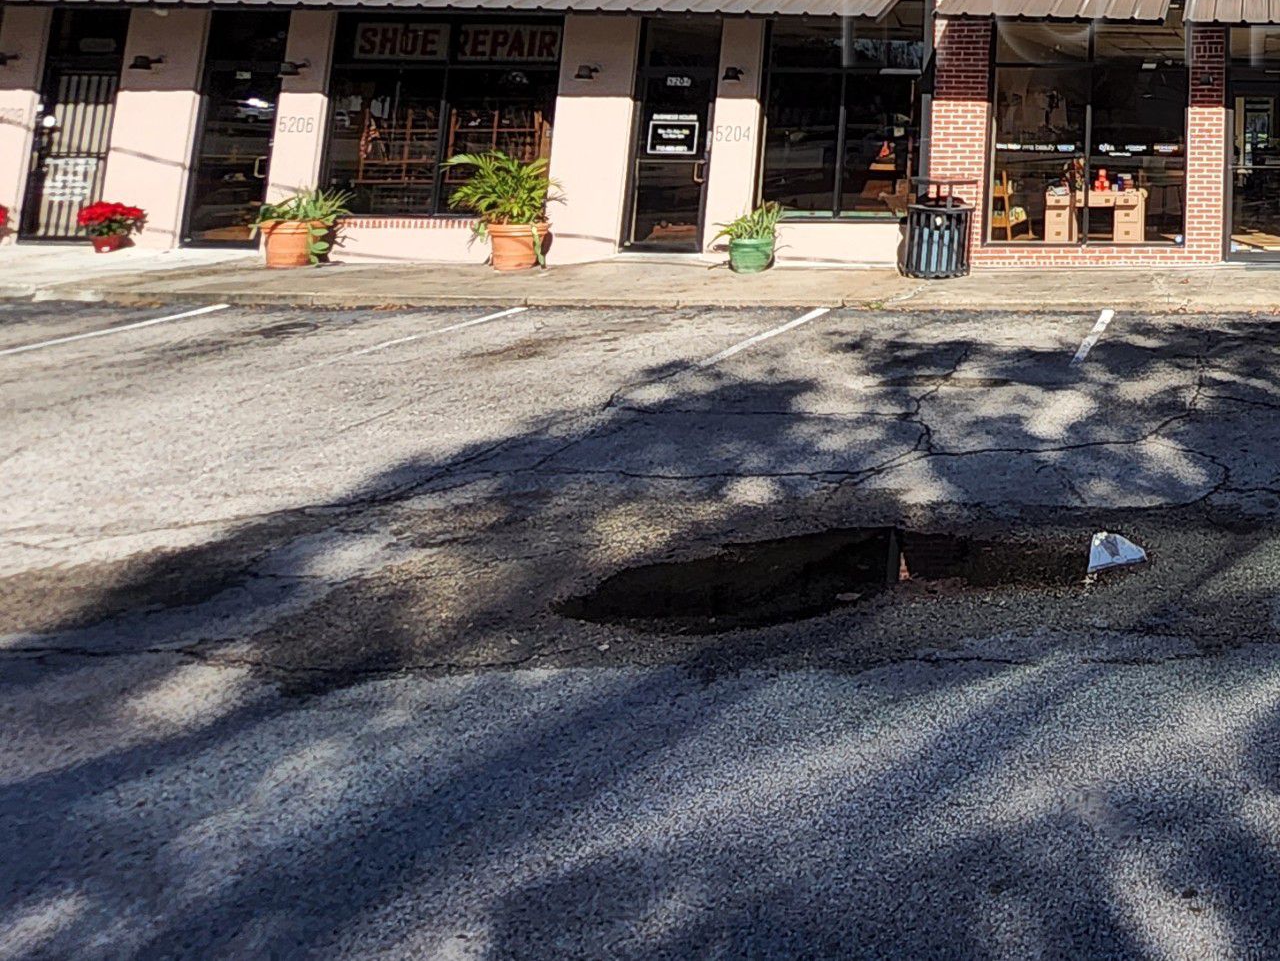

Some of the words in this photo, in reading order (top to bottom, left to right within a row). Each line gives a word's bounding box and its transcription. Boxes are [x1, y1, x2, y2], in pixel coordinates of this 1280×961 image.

[359, 27, 441, 56] SHOE
[459, 29, 557, 57] REPAIR
[278, 116, 315, 134] 5206
[715, 125, 751, 143] 5204
